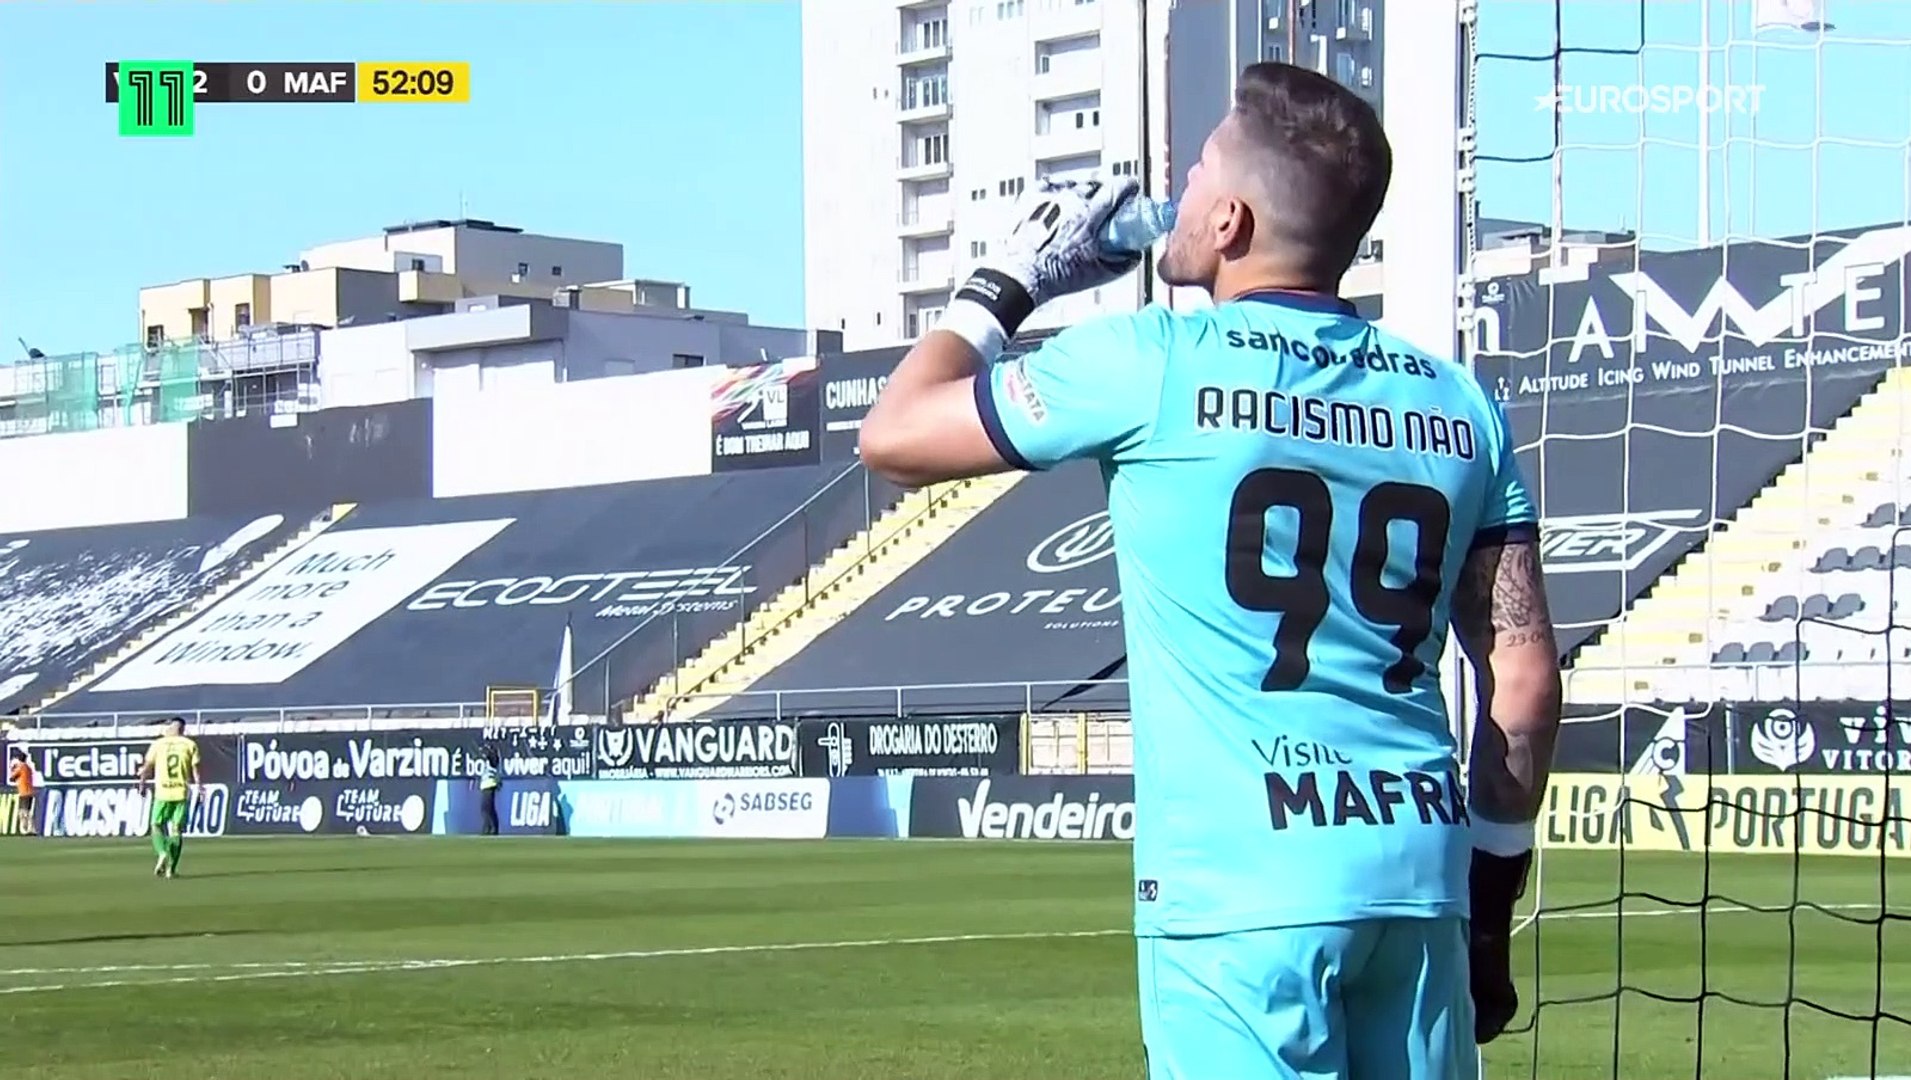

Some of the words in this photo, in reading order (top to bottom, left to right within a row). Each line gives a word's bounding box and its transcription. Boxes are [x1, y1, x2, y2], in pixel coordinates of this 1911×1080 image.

[1196, 385, 1394, 449] RACISMO
[1405, 406, 1474, 460] NÃO
[286, 548, 397, 576] Much
[248, 580, 350, 602] more
[407, 564, 758, 611] ECOSTEEL
[1224, 466, 1452, 695] 99
[200, 611, 288, 633] than
[884, 587, 1121, 621] PROTEU
[633, 724, 796, 764] VANGUARD
[869, 724, 922, 755] DROGARIA
[924, 723, 943, 755] DO
[947, 723, 998, 755] DESTERRO
[246, 738, 331, 780] Póvoa
[348, 736, 449, 778] Varzim
[504, 751, 549, 776] viver
[551, 751, 591, 780] aqui!
[244, 790, 280, 804] TEAM
[343, 789, 380, 804] TEAM
[510, 791, 550, 827] LIGA
[739, 791, 813, 812] SABSEG
[957, 777, 1135, 839] Vendeiro
[1547, 784, 1633, 845] LIGA
[1704, 784, 1911, 851] PORTUGA
